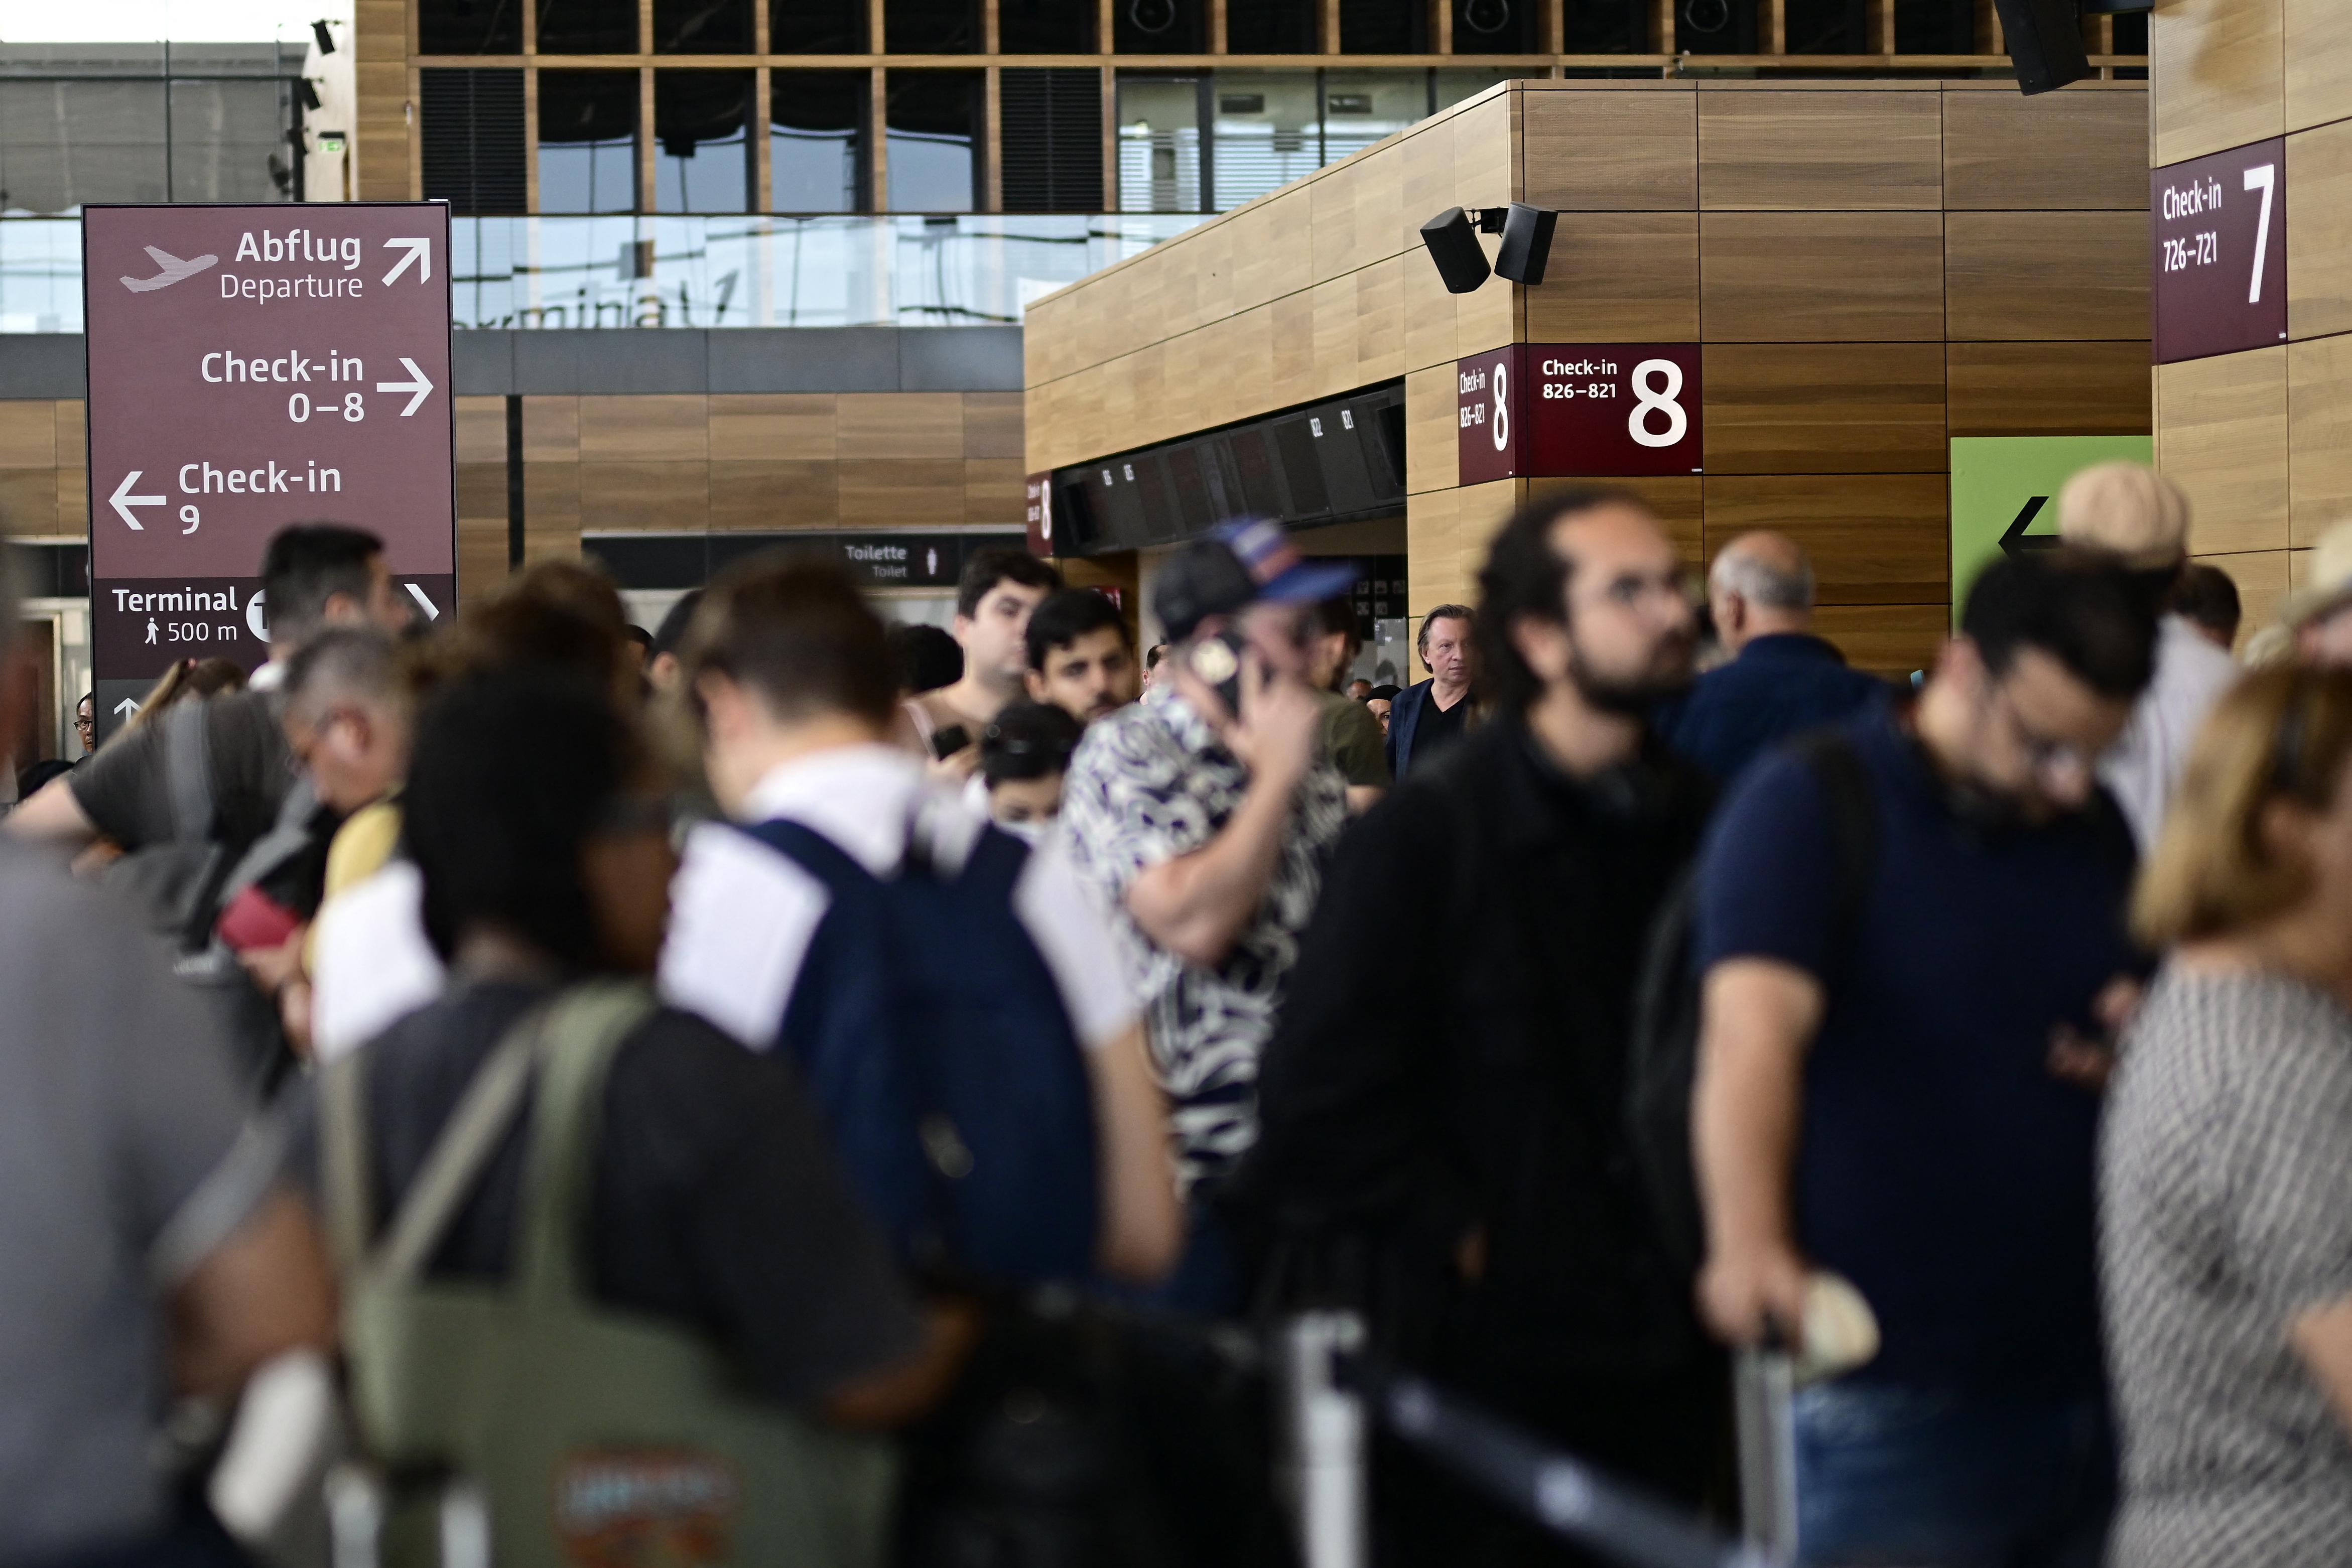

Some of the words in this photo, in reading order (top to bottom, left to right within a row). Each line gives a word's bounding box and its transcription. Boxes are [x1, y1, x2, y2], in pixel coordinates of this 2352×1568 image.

[2163, 176, 2222, 220] Check-in
[2243, 163, 2275, 303] 7
[235, 228, 361, 271] Abflug
[221, 274, 363, 305] Departure
[201, 349, 363, 382] Check-in
[1460, 367, 1485, 394] Check-in
[1542, 359, 1617, 375] Check-in
[1493, 363, 1508, 451] 8
[1628, 359, 1687, 447] 8
[179, 460, 341, 494] Check-in
[179, 505, 200, 535] 9
[1041, 479, 1052, 540] 8
[845, 545, 907, 561] Toilette
[872, 565, 907, 577] Toilet
[112, 586, 238, 612] Terminal
[168, 622, 209, 641] 500
[218, 624, 237, 640] m
